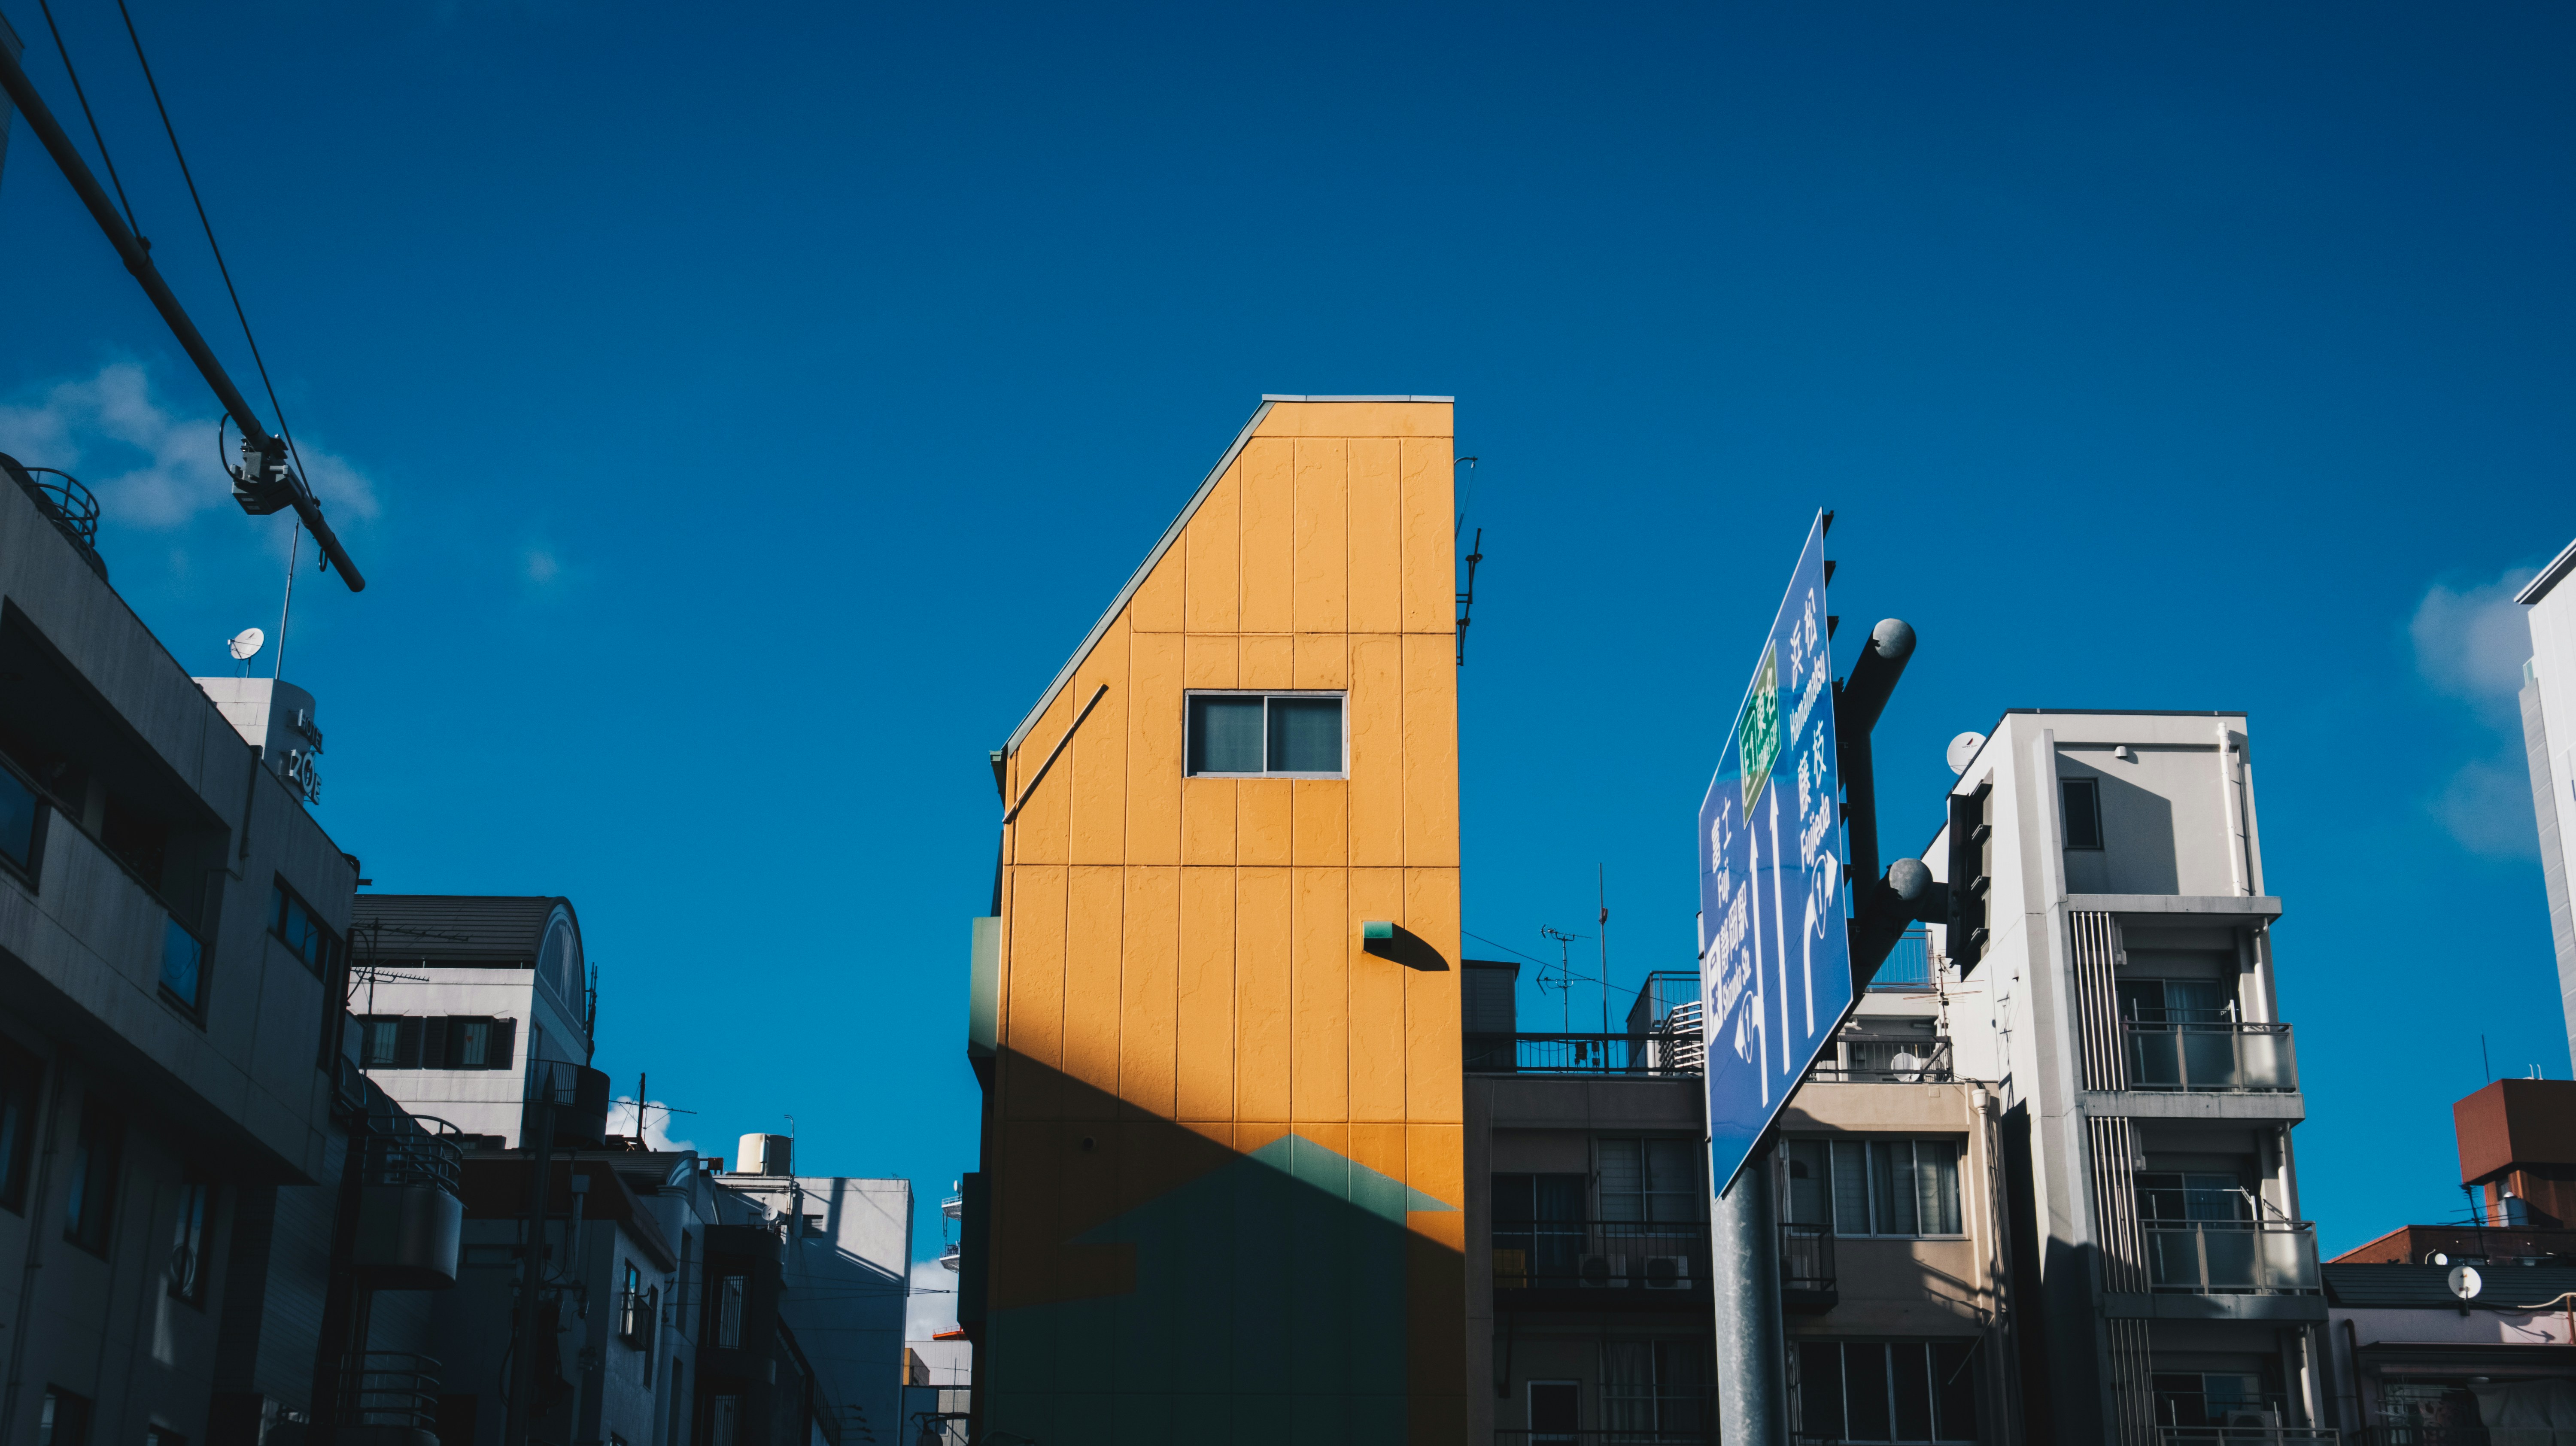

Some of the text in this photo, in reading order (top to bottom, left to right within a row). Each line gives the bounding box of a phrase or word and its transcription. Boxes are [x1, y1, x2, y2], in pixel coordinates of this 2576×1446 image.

[1790, 587, 1817, 693] 浜松
[298, 709, 324, 754] HOTEL
[1756, 668, 1775, 744] 東名
[1790, 650, 1826, 751] Hamamatsu
[1744, 731, 1755, 788] E1
[1759, 735, 1771, 777] TOMEI
[1798, 720, 1826, 821] 藤枝
[1711, 797, 1731, 874] 富士
[1800, 793, 1830, 873] Fujieda
[1717, 857, 1729, 908] Fuji
[1720, 881, 1748, 978] 静岡駅
[1723, 945, 1751, 1021] Shizuoka Sta.
